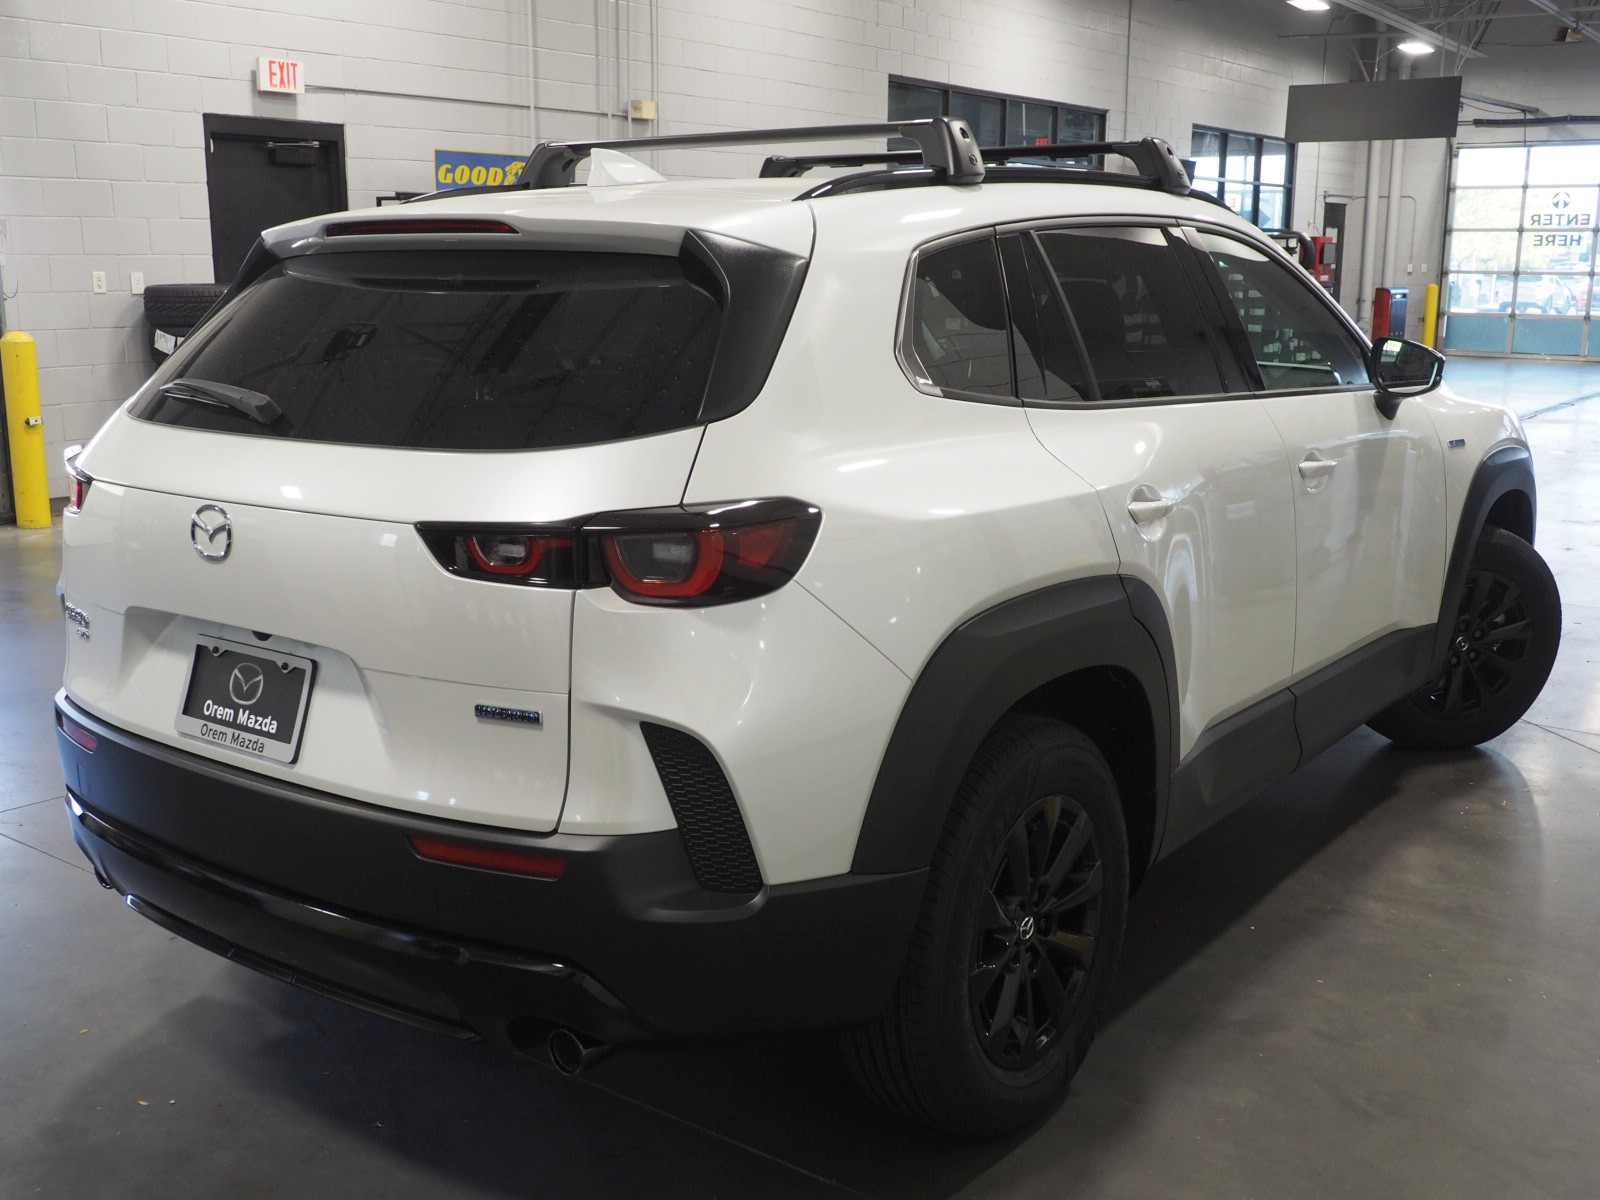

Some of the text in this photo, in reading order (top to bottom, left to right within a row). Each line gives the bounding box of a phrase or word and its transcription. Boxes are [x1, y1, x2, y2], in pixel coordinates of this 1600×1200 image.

[268, 60, 298, 90] EXIT
[203, 699, 278, 734] Orem Mazda
[200, 723, 265, 754] Orem Mazda
